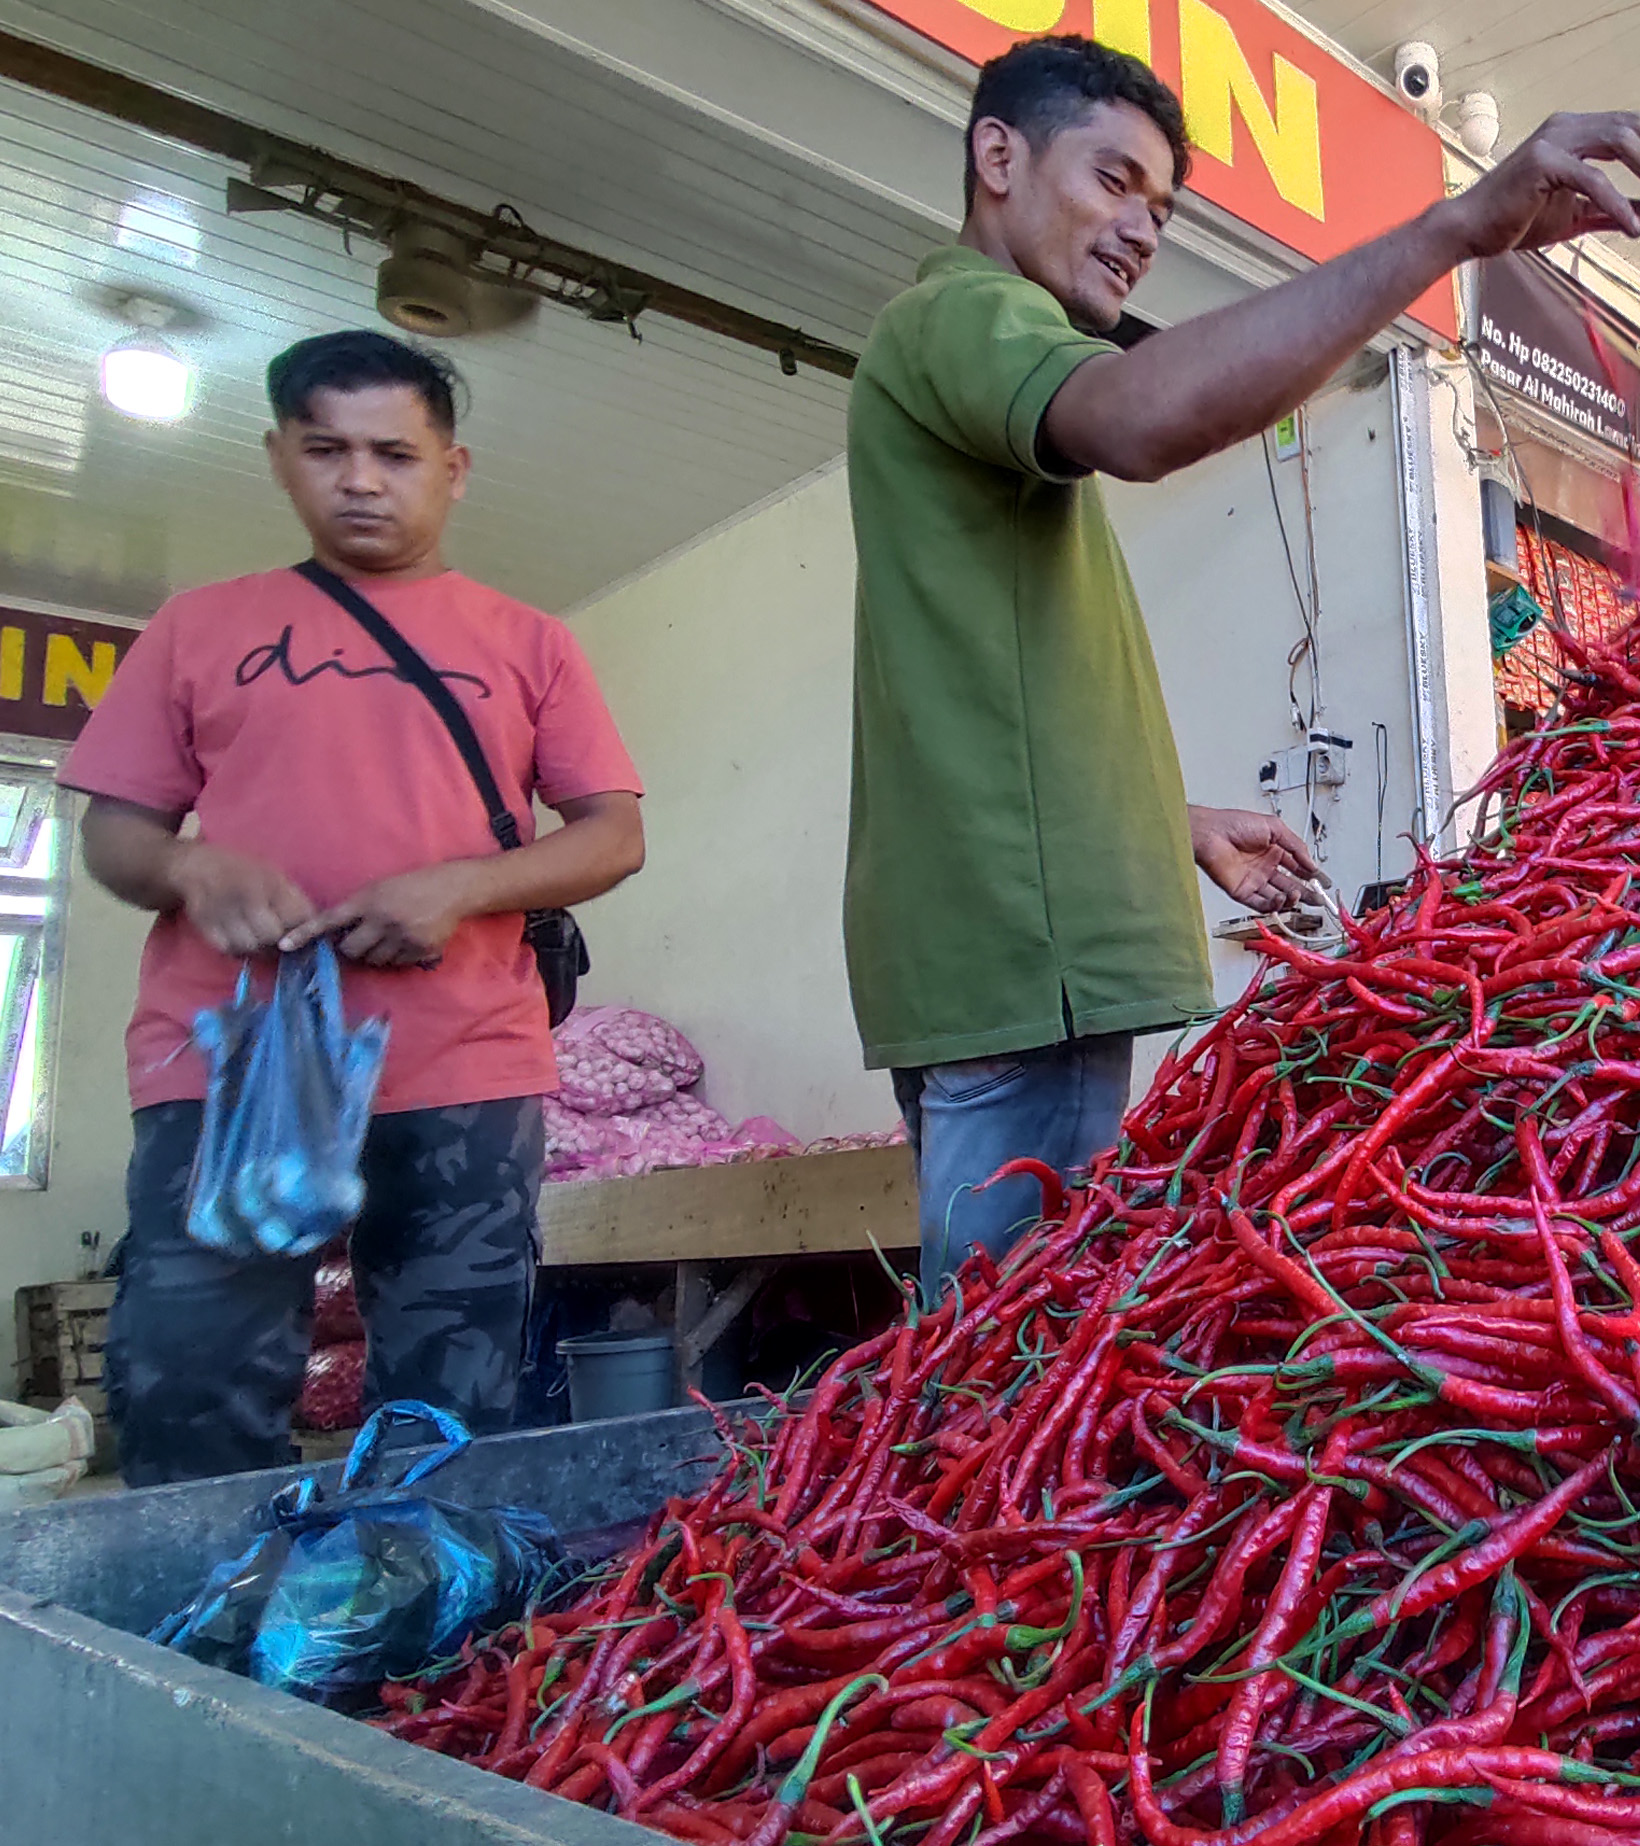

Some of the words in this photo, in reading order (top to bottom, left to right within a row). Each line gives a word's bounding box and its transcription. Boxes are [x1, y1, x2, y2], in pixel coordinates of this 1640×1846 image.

[1481, 313, 1506, 349] No.
[1508, 331, 1530, 366] Hp
[1532, 347, 1625, 418] 082250231400
[1481, 348, 1522, 389] Pasar
[1522, 374, 1539, 399] Al
[1541, 382, 1594, 431] Mahirah
